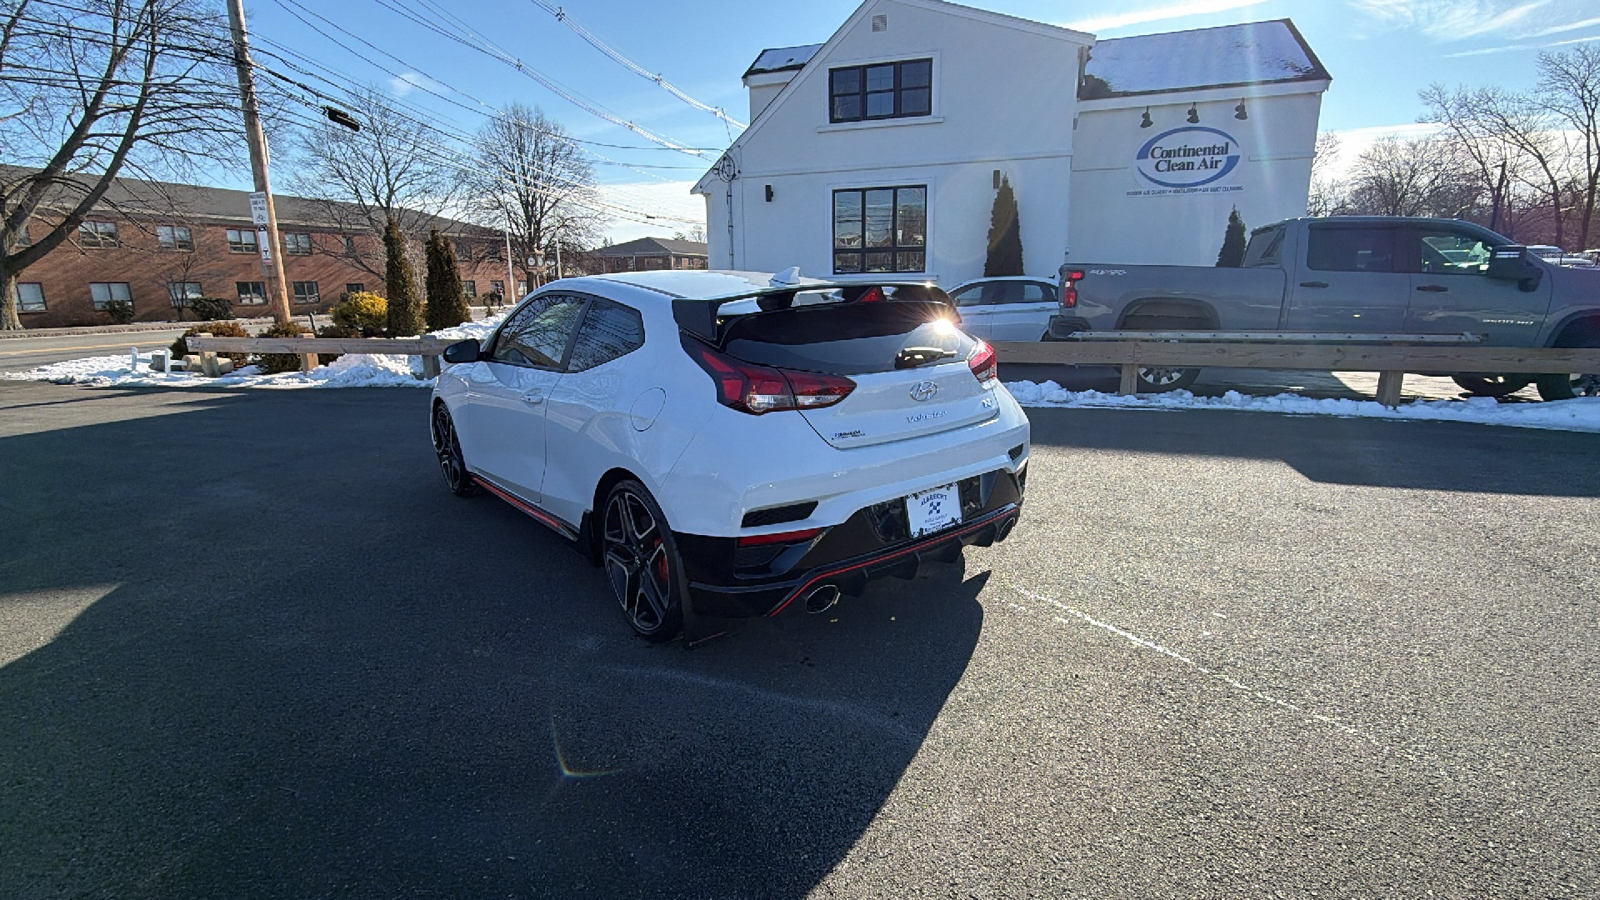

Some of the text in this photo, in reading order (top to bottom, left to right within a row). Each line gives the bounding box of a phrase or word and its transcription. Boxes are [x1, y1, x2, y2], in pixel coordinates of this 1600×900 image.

[1150, 141, 1229, 159] Continental
[1154, 157, 1222, 172] Clean Air
